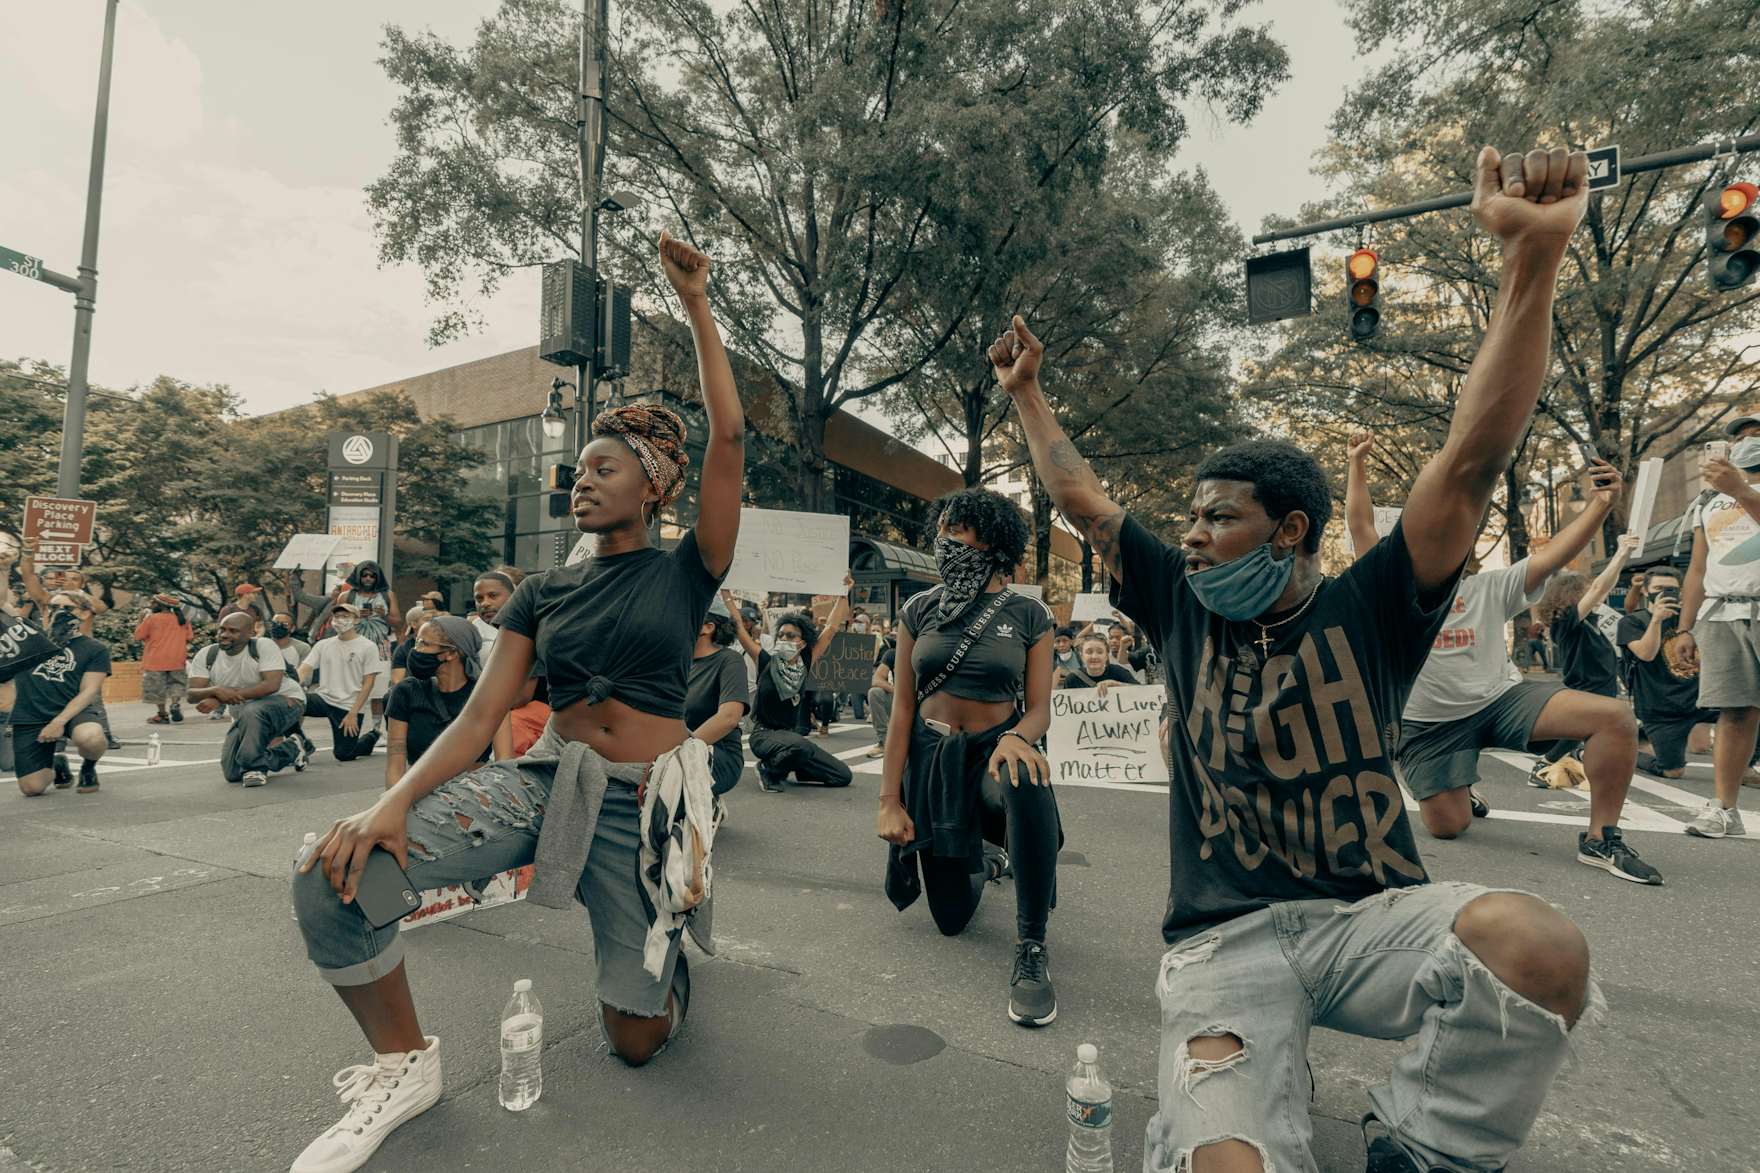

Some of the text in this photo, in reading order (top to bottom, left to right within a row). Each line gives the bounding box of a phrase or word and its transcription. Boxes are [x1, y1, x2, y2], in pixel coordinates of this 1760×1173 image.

[10, 261, 39, 279] 300
[32, 499, 89, 514] Discovery
[44, 510, 74, 520] Place
[37, 518, 80, 532] Parking
[34, 553, 74, 561] BLOCK
[39, 545, 72, 553] NEXT
[946, 638, 972, 671] GUESS
[811, 660, 869, 681] NO Peace
[1053, 693, 1110, 717] Black
[1187, 625, 1383, 781] HIGH
[1076, 719, 1151, 745] ALWAYS
[1193, 755, 1425, 885] POWER
